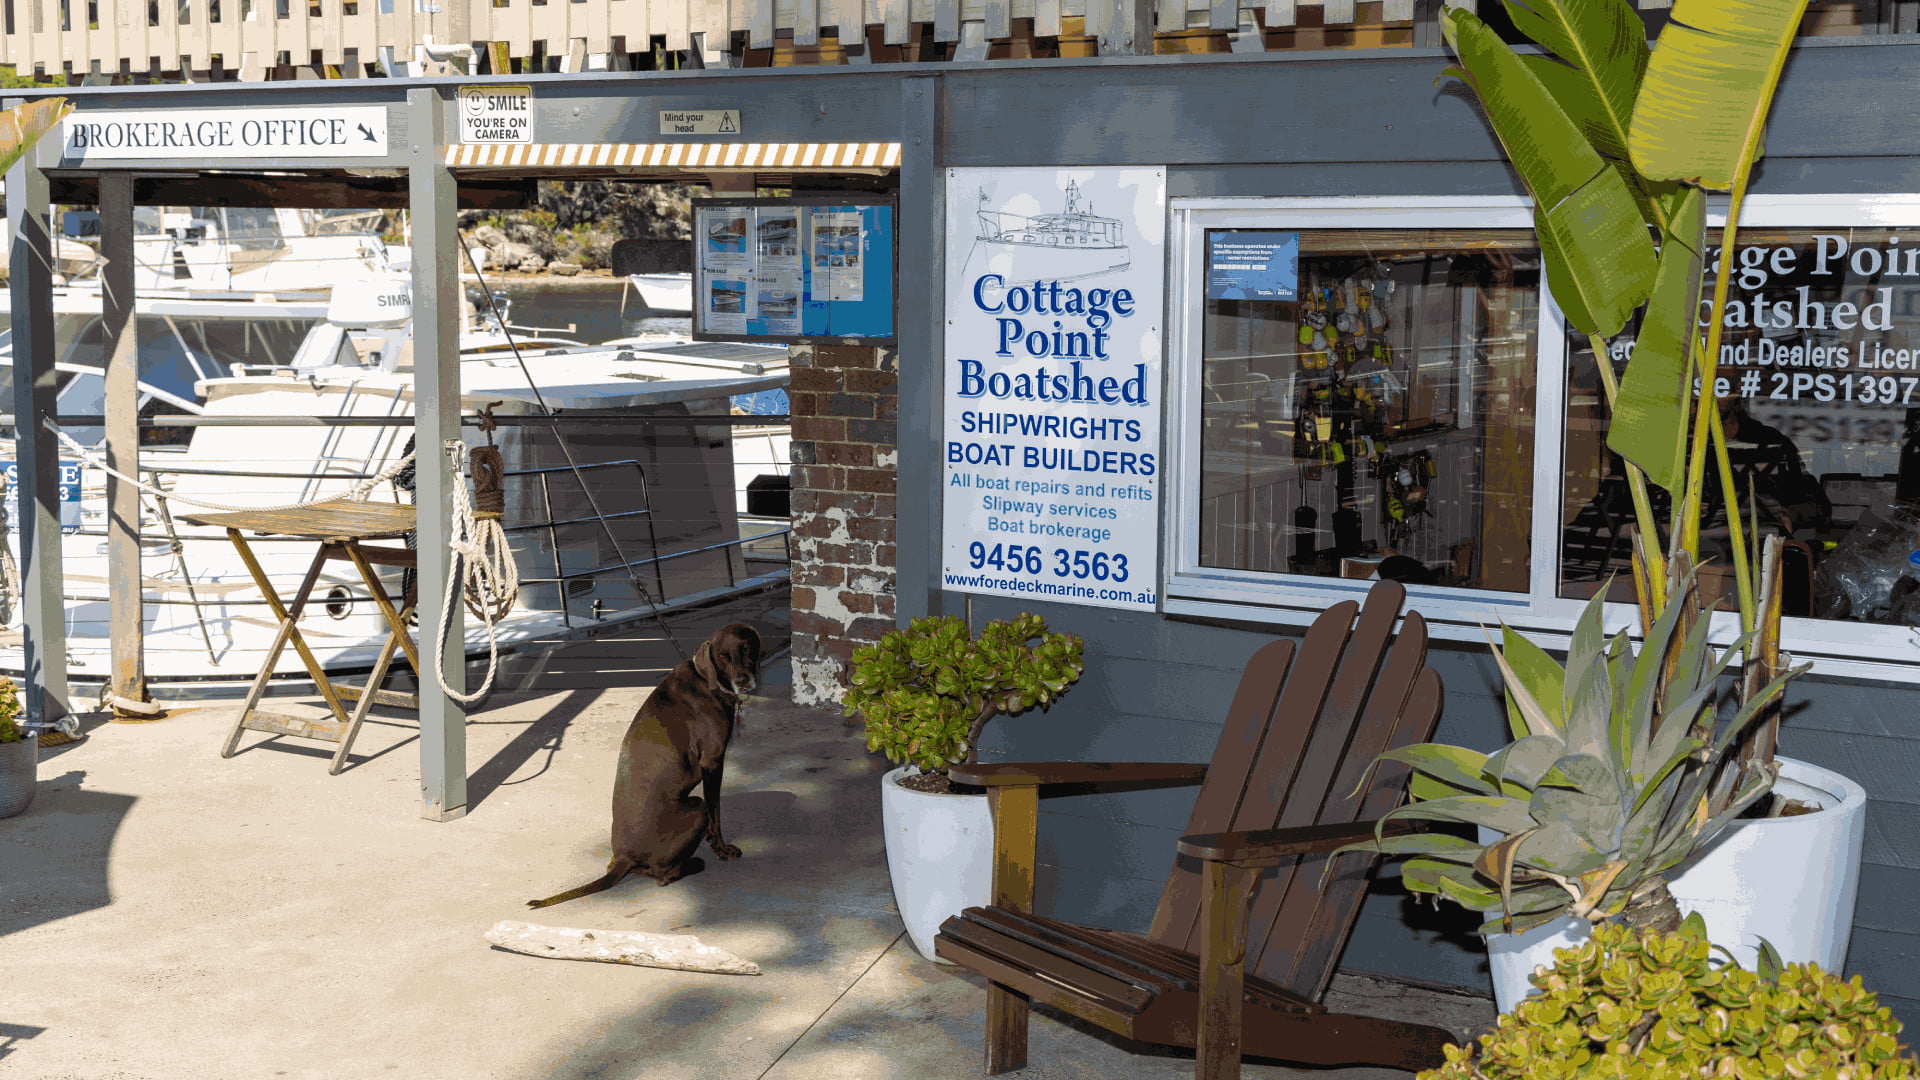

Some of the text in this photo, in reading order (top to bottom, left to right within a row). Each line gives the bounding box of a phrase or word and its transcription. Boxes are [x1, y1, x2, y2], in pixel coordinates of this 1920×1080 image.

[488, 96, 527, 111] SMILE
[664, 113, 704, 124] Mind your
[72, 118, 348, 149] BROKERAGE OFFICE
[467, 117, 527, 128] YOU'RE ON
[475, 129, 520, 140] CAMERA
[675, 124, 695, 133] head
[973, 273, 1136, 329] Cottage
[1698, 285, 1895, 331] oatshed
[995, 317, 1110, 361] Point
[1757, 338, 1851, 369] Dealers
[956, 358, 1150, 407] Boatshed
[1740, 369, 1761, 398] #
[1769, 372, 1919, 406] 2PS1397
[960, 410, 1142, 443] SHIPWRIGHTS
[947, 441, 1156, 476] BOAT BUILDERS
[950, 472, 1153, 502] All boat repairs and refits
[982, 495, 1118, 520] Slipway services
[988, 516, 1111, 544] Boat brokerage
[969, 540, 1130, 583] 9456 3563
